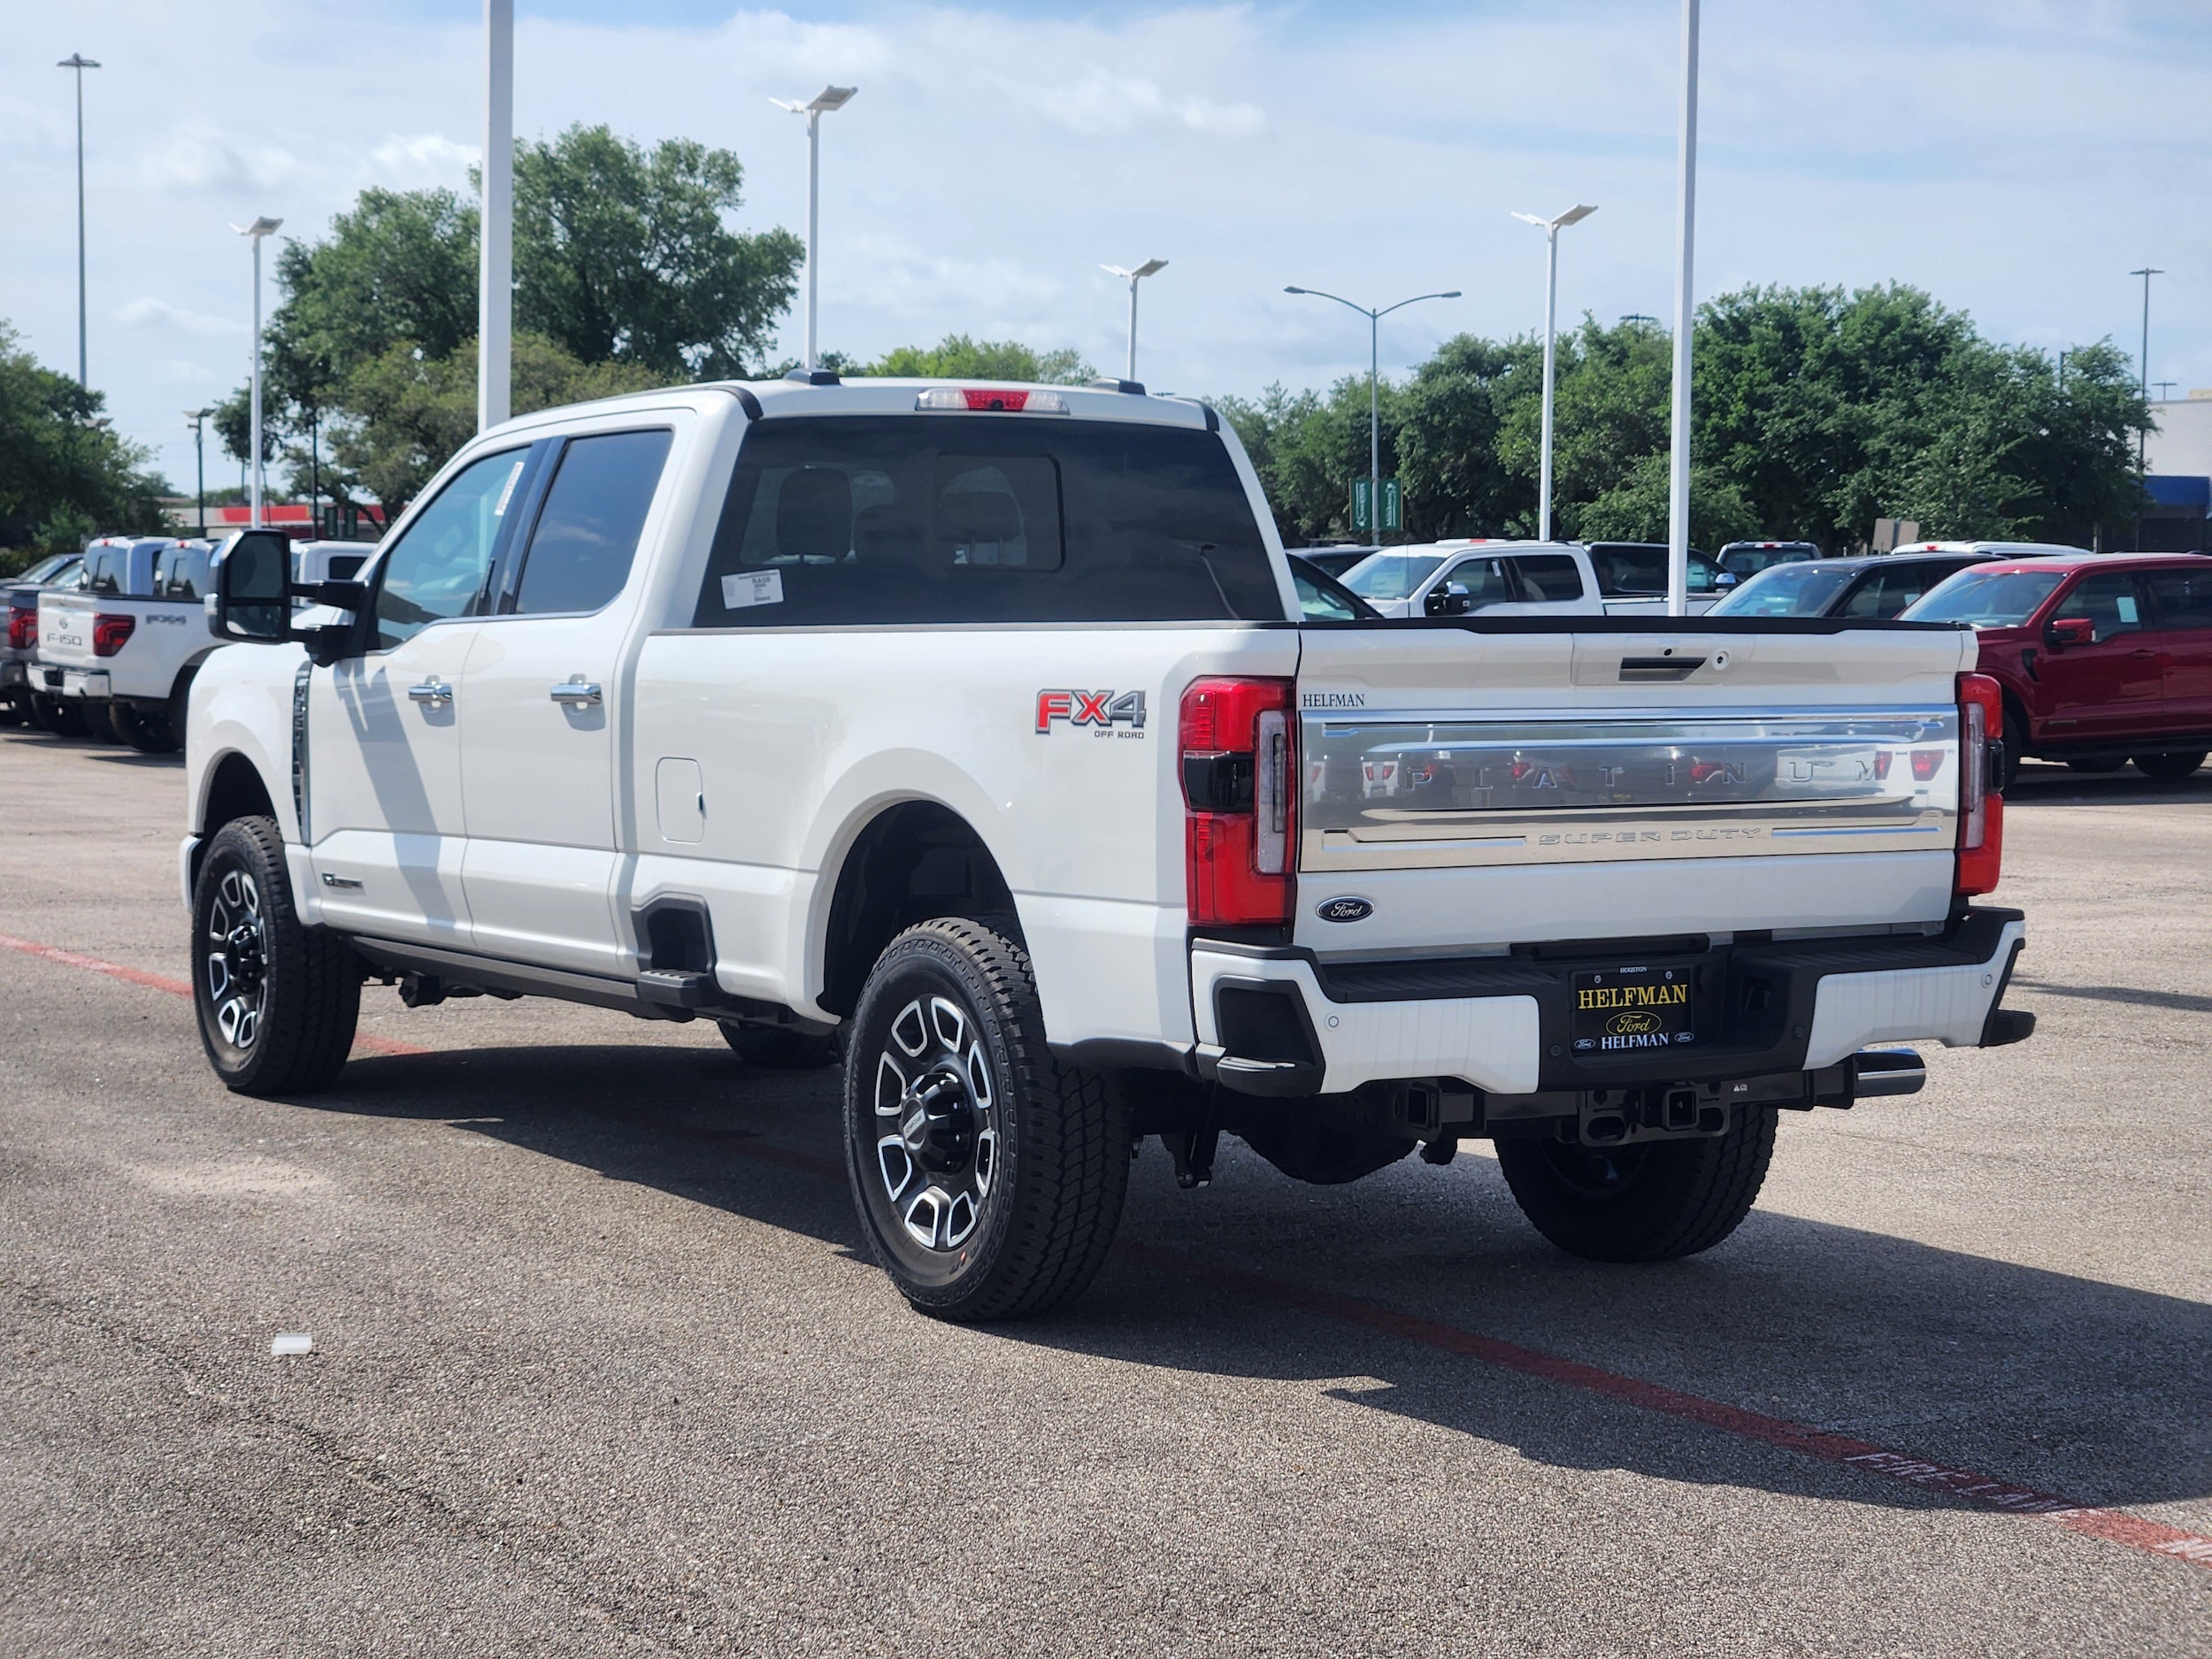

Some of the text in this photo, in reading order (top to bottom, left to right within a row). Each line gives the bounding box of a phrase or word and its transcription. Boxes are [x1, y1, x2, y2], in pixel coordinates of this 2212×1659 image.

[47, 633, 82, 646] F-150
[1302, 694, 1364, 707] HELFMAN
[1035, 688, 1147, 735] FX4
[1407, 761, 1879, 790] PLATINUM
[1539, 827, 1762, 846] SUPER DUTY
[1330, 901, 1363, 917] Ford
[1578, 984, 1687, 1010] HELFMAN
[1617, 1014, 1651, 1033] Ford
[1601, 1033, 1670, 1050] HELFMAN
